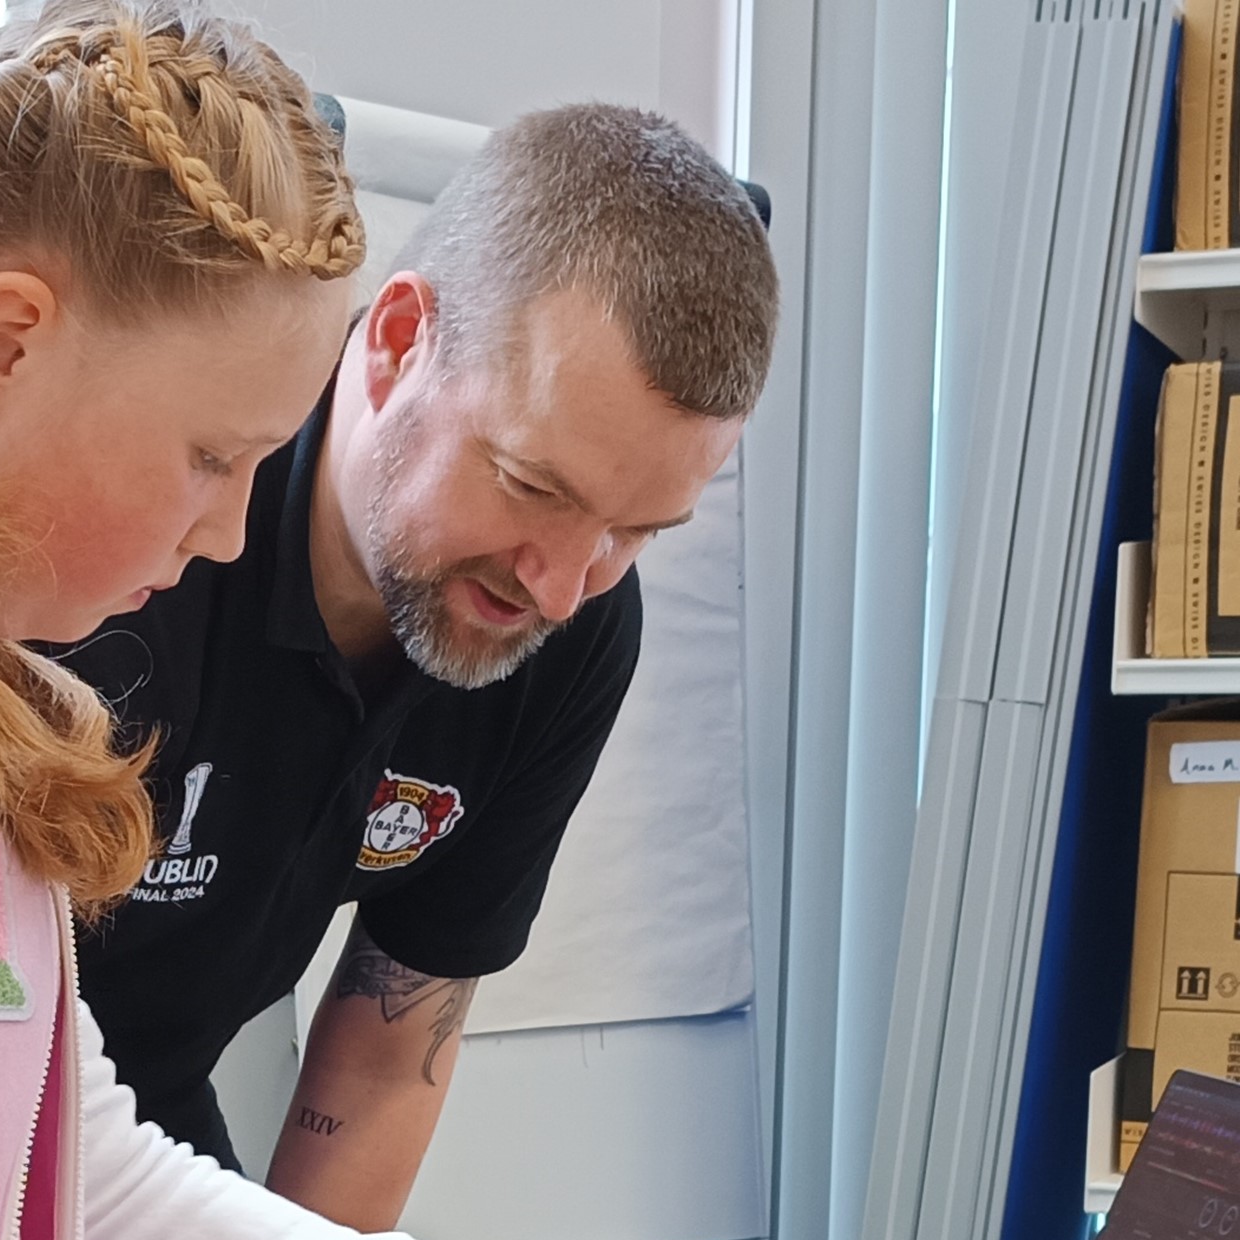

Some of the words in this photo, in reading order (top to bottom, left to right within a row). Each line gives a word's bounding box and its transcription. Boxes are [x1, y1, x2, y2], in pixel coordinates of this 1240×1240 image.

[399, 786, 426, 802] 1904
[374, 820, 418, 836] BAYER
[360, 851, 411, 865] verkusen
[143, 854, 219, 885] UBLIN
[170, 885, 205, 902] 2024
[300, 1106, 345, 1136] XXIV
